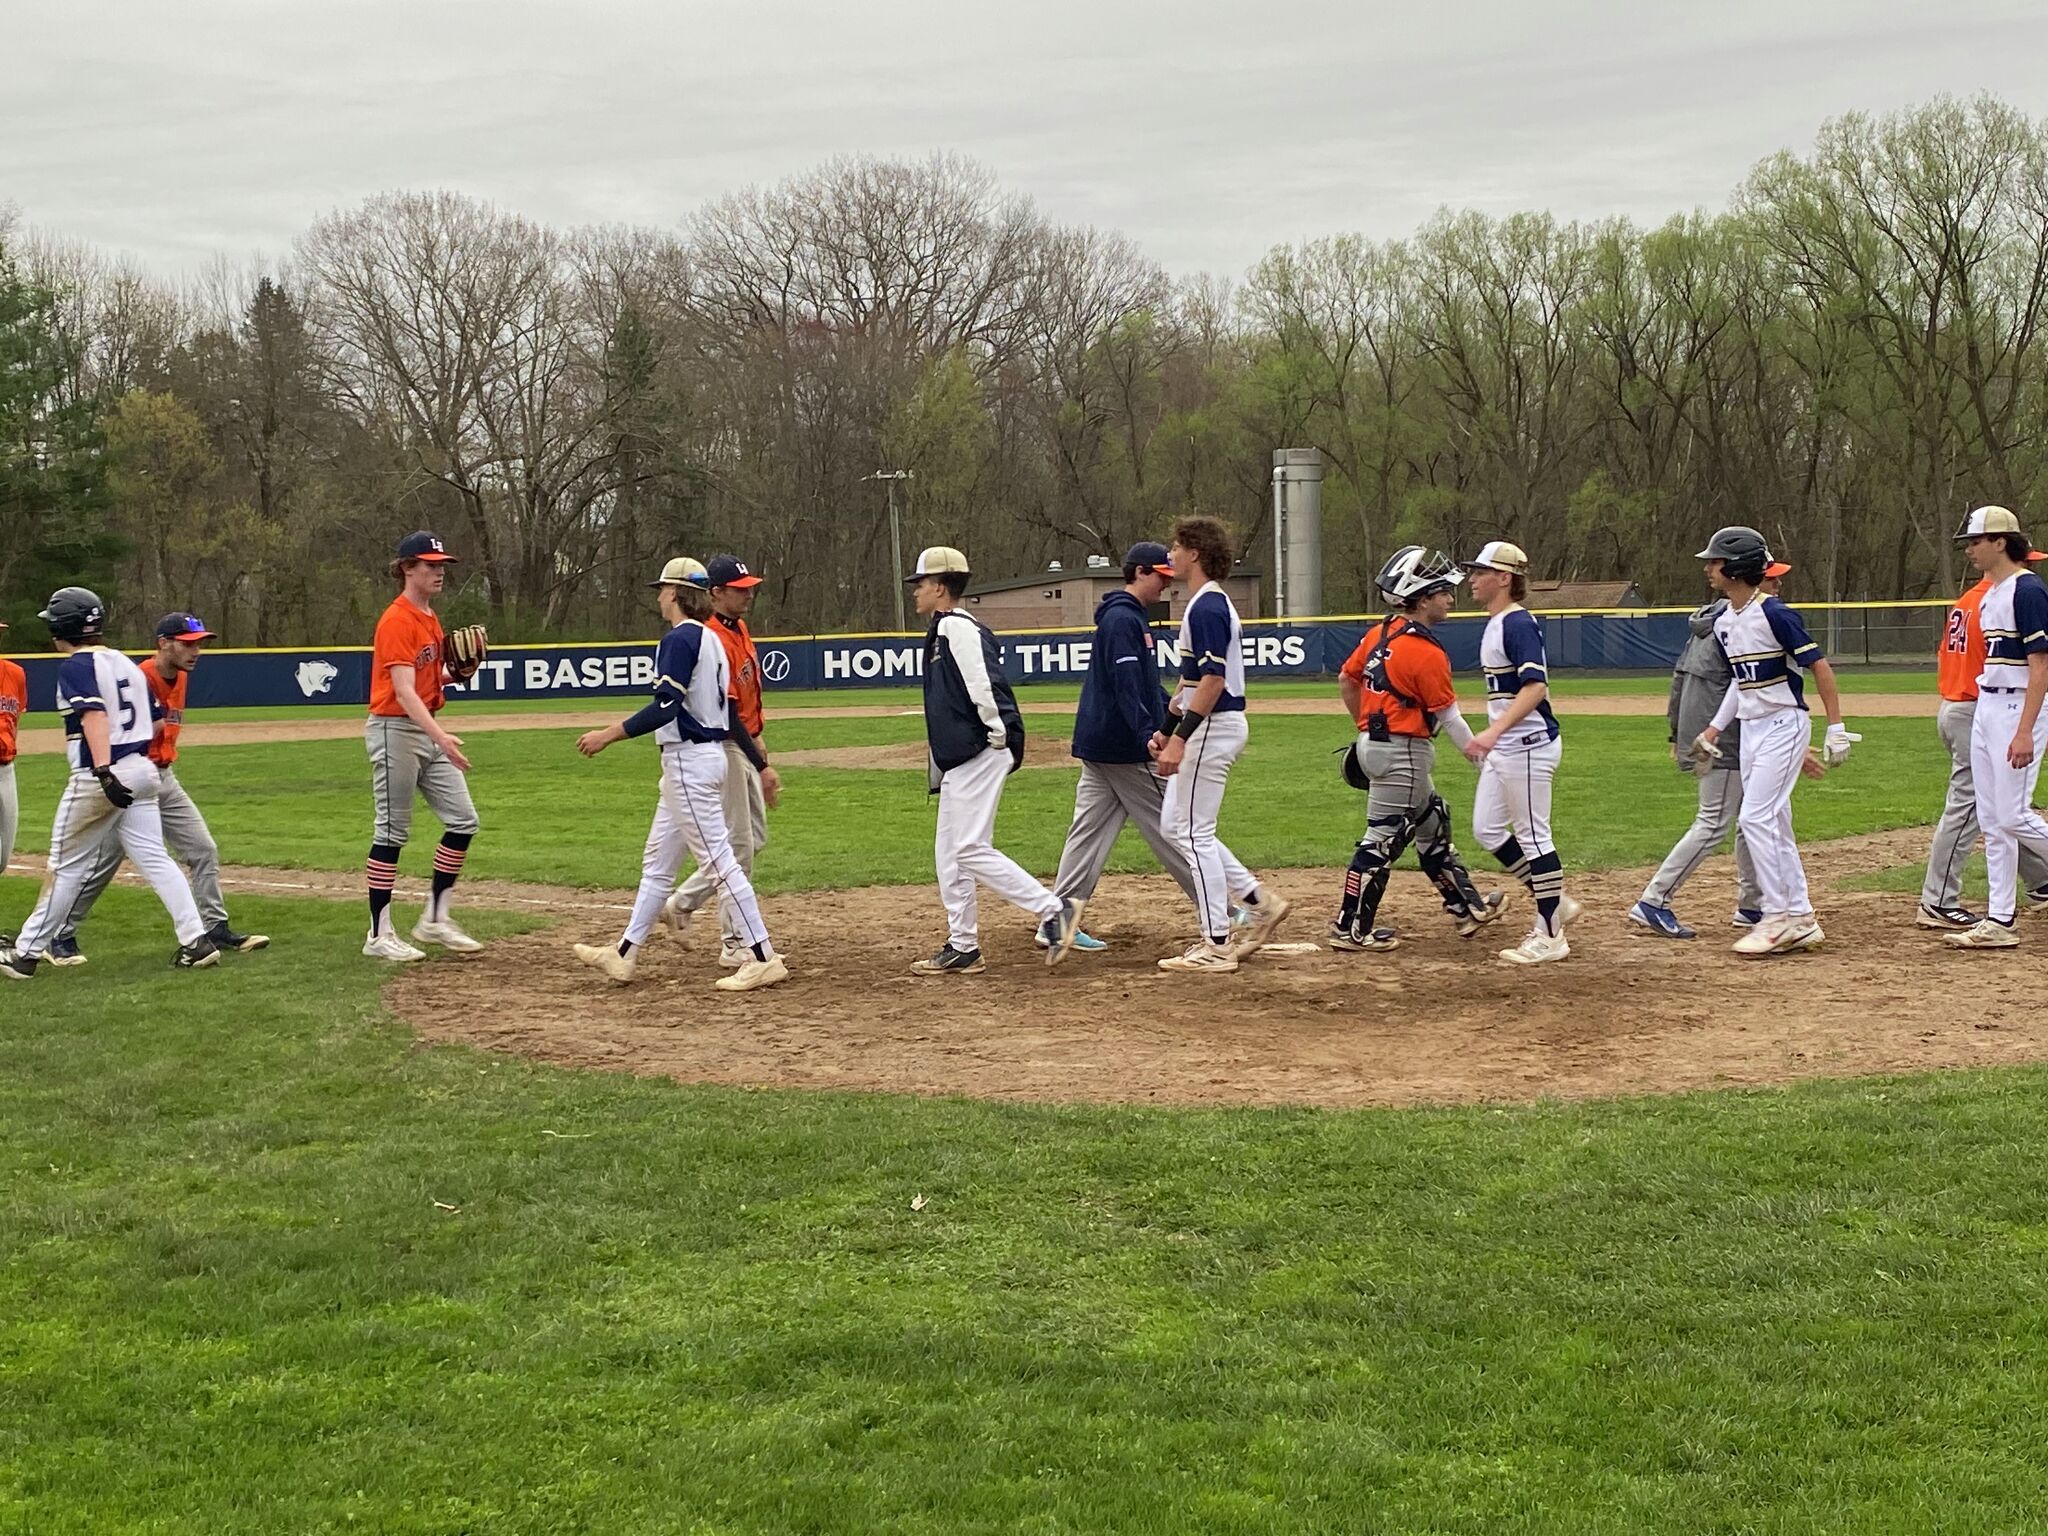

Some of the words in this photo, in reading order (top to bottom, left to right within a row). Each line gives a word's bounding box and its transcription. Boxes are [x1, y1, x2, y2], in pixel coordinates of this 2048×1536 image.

[1947, 608, 1972, 654] 24
[1015, 642, 1093, 674] THE
[116, 679, 136, 731] 5
